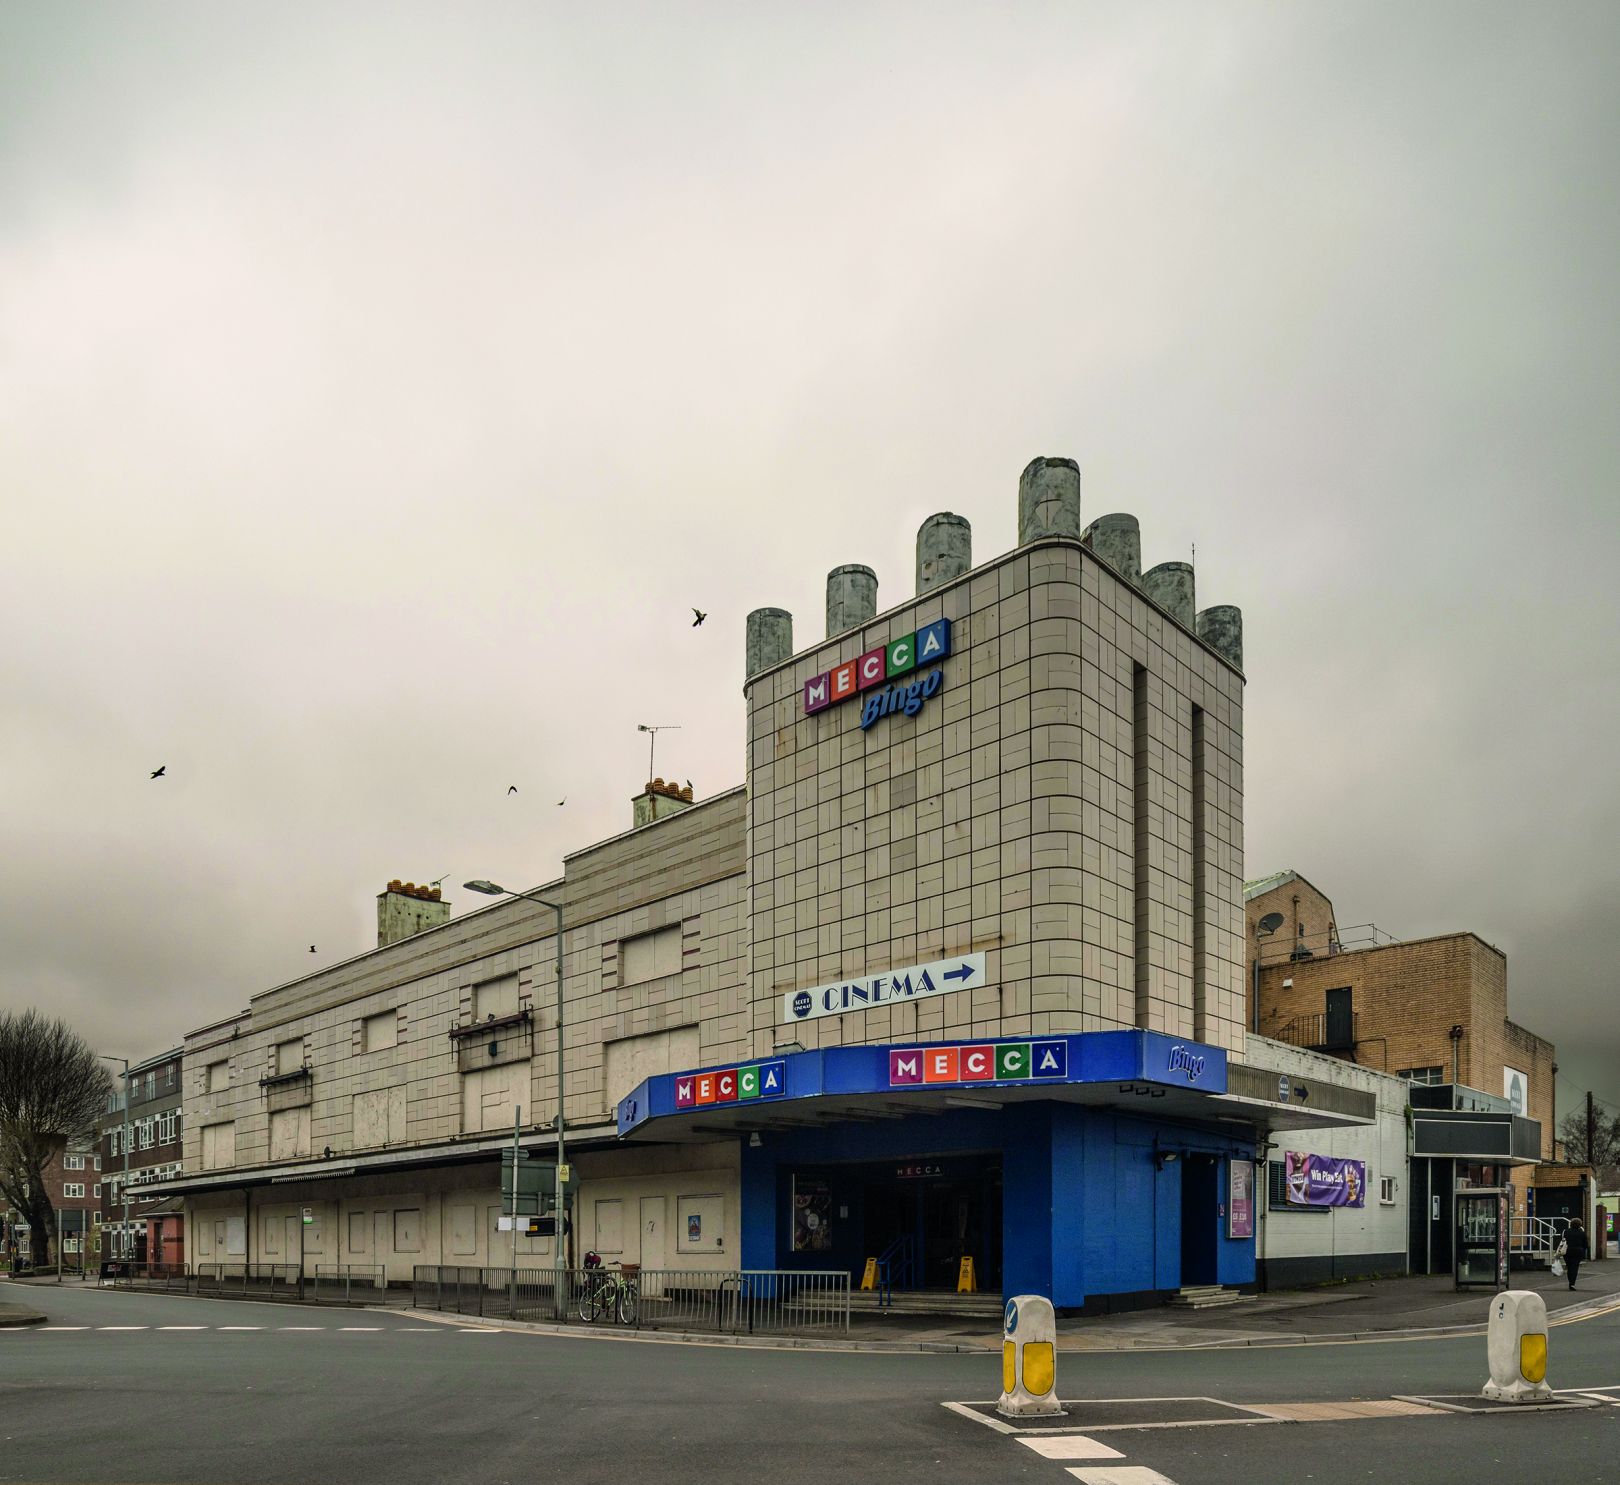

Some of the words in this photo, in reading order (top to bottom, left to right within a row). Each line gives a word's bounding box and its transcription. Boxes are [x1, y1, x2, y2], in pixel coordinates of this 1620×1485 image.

[808, 630, 941, 706] MECCA
[861, 669, 944, 731] Bingo
[821, 968, 937, 1011] CINEMA
[896, 1048, 1059, 1077] MECCA
[1168, 1045, 1206, 1082] Bingo
[678, 1069, 778, 1101] MECCA
[896, 1165, 942, 1176] MECCA
[1311, 1169, 1322, 1181] Win
